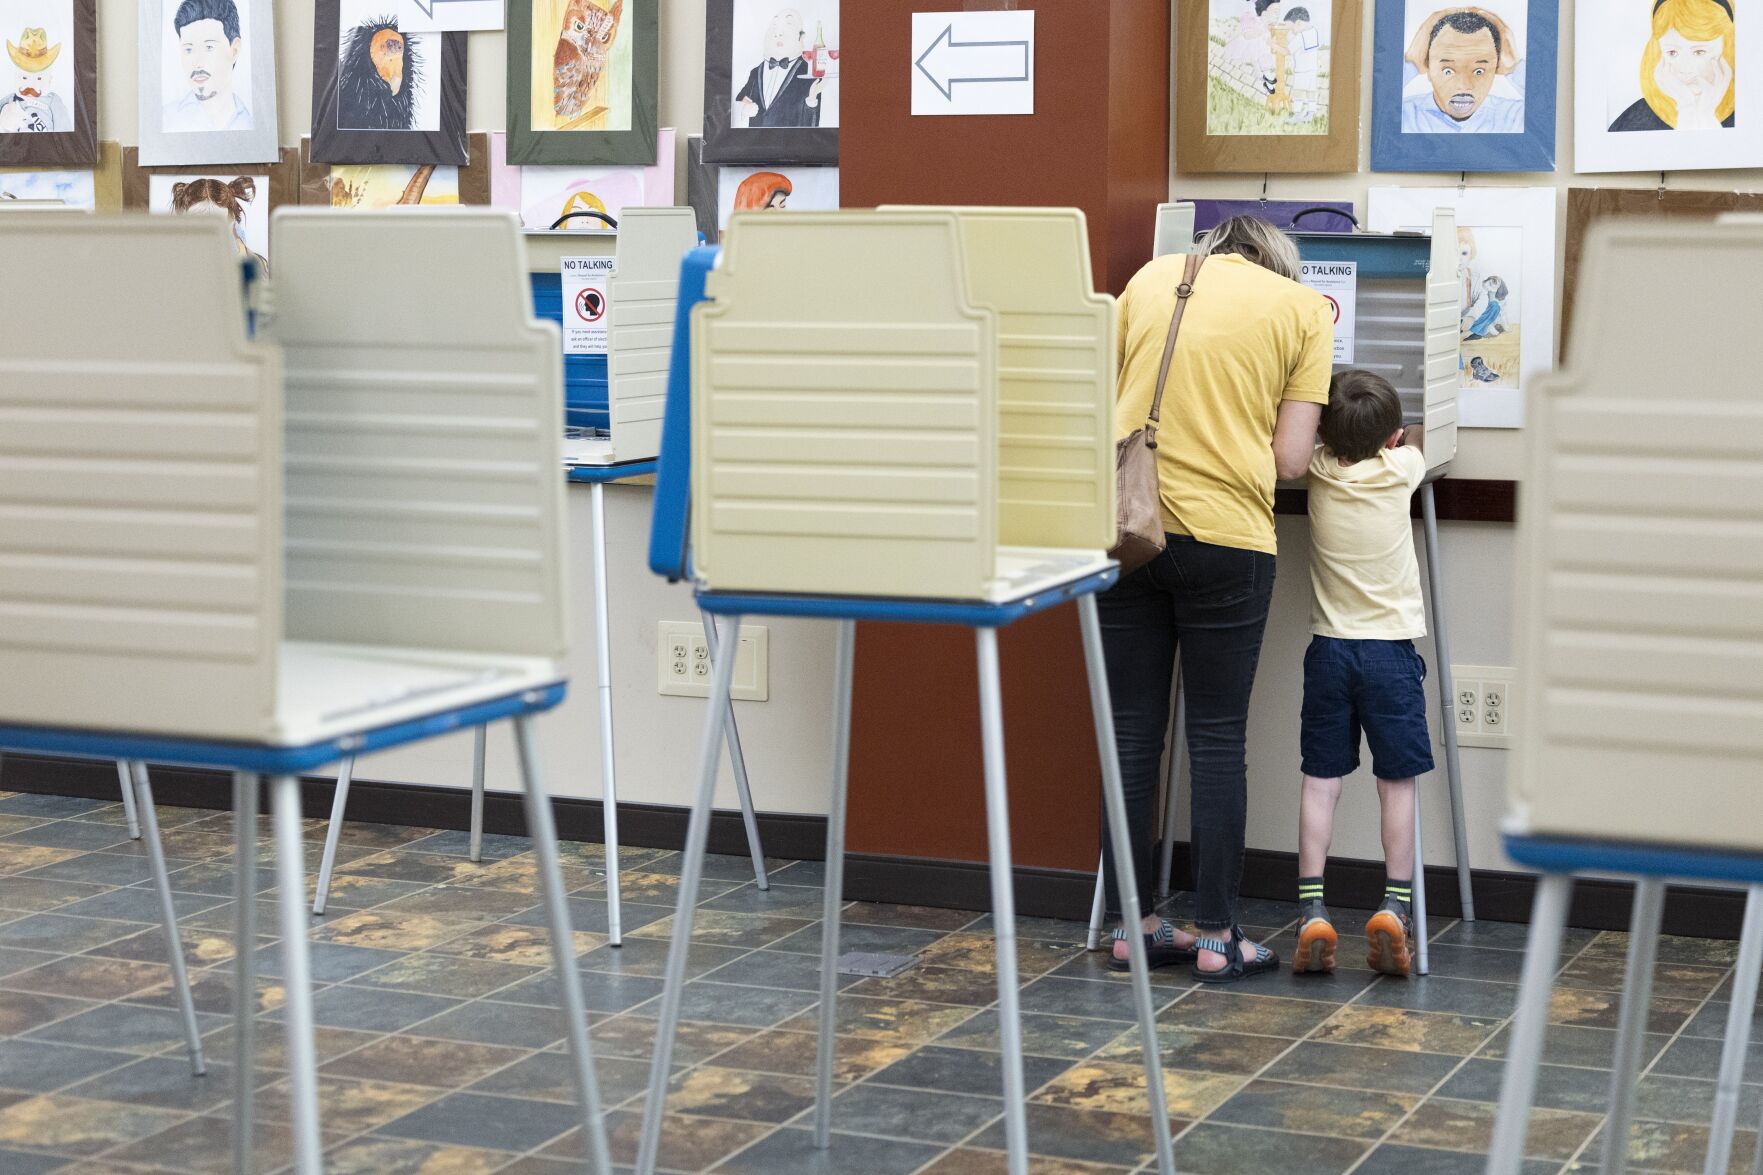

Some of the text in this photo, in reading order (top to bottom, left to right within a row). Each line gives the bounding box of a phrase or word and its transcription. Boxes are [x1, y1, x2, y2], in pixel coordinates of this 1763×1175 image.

[564, 260, 613, 270] NO TALKING
[1311, 265, 1352, 276] TALKING
